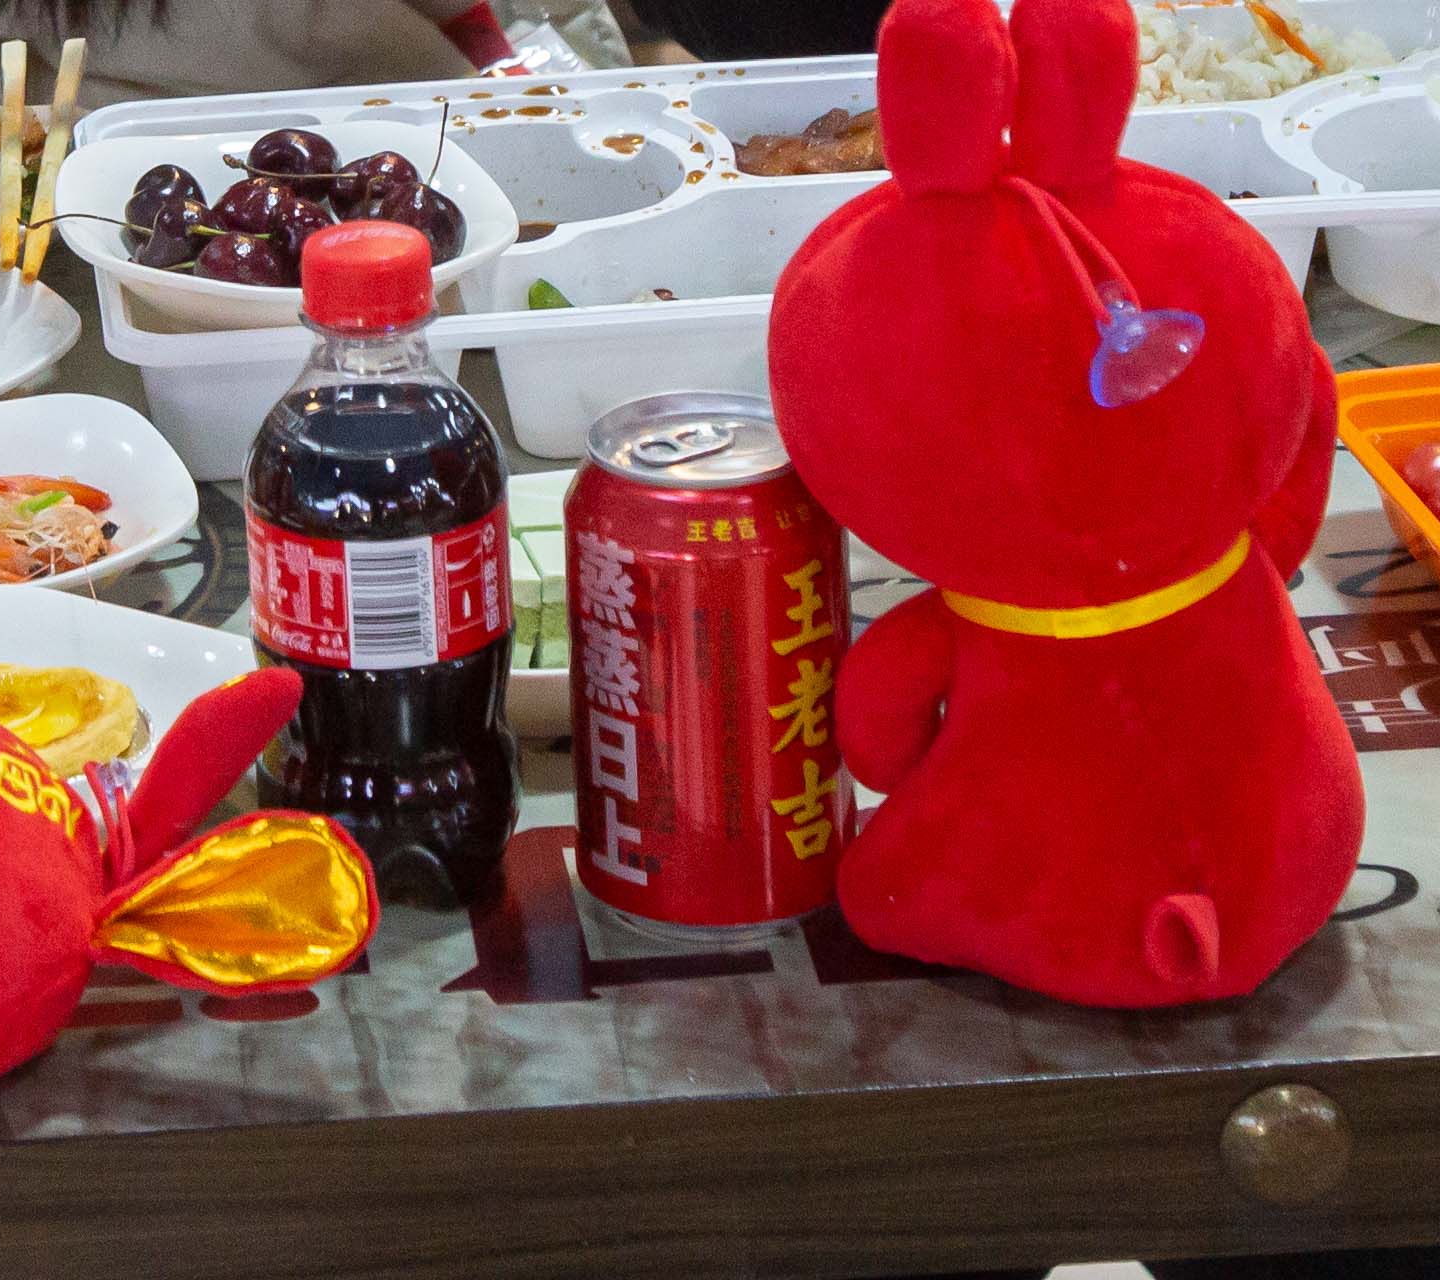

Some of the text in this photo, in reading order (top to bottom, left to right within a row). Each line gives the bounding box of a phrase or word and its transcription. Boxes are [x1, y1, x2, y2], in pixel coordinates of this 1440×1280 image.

[686, 517, 758, 543] 王老吉
[575, 528, 649, 888] 蒸蒸日上
[767, 559, 839, 861] 王老吉
